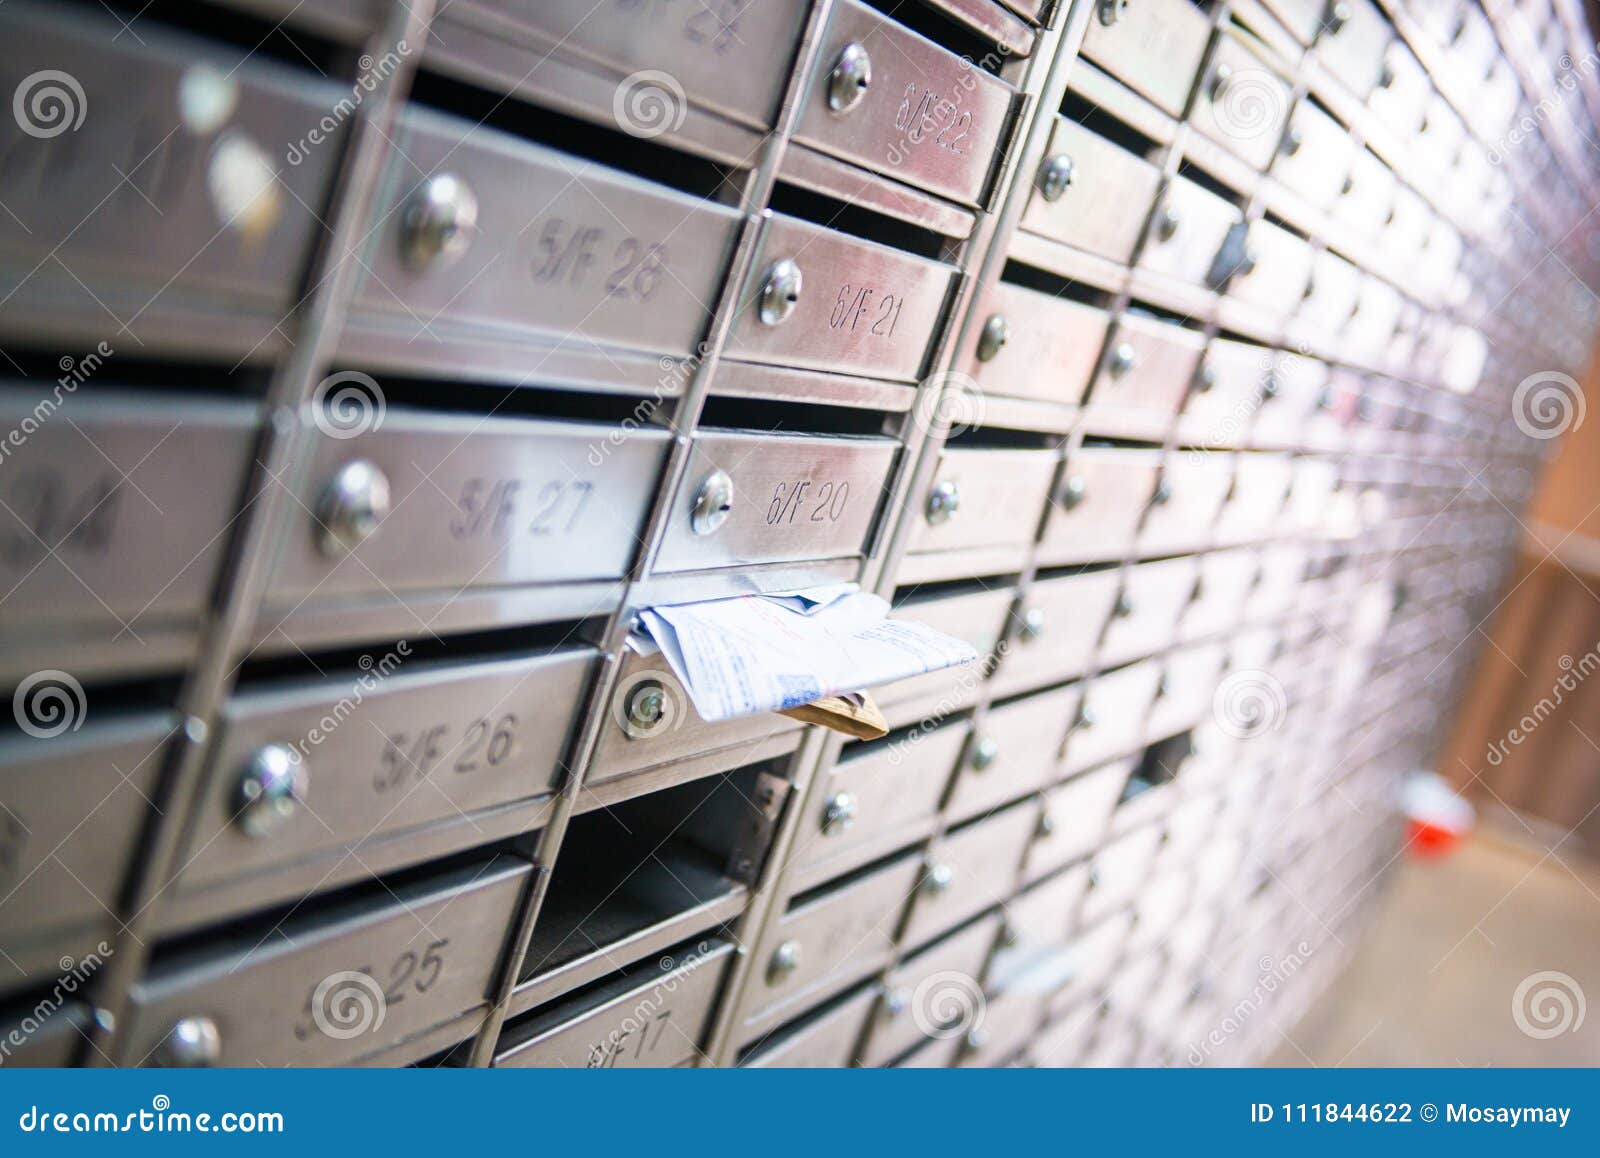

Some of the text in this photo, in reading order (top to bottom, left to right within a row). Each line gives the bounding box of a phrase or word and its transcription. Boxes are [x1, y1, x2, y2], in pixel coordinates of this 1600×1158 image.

[895, 81, 972, 154] 6/F 22
[830, 283, 904, 338] 6/F 21
[766, 480, 850, 525] 6/F 20
[384, 938, 449, 1007] 25
